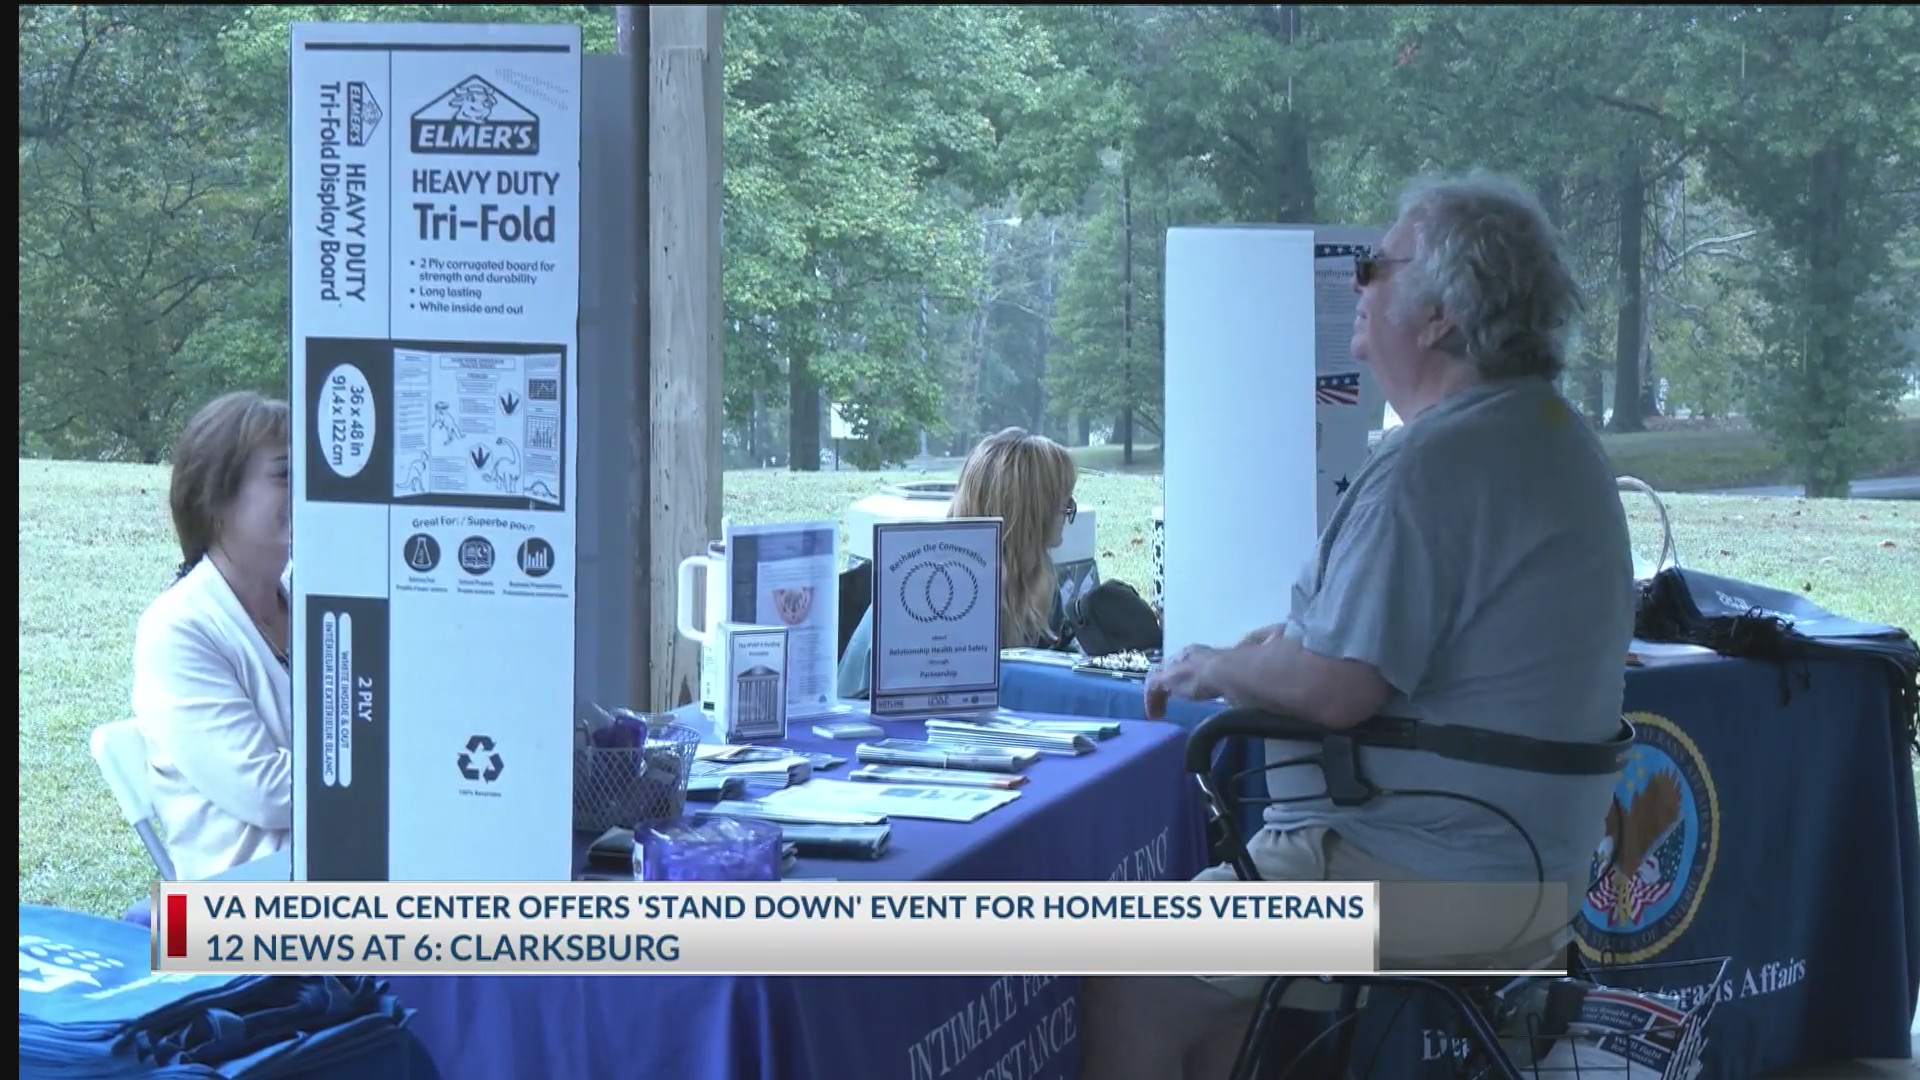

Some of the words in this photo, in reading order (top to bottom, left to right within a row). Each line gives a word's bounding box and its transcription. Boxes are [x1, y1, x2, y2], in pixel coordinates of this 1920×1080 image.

[320, 82, 341, 159] Tri-Fold
[350, 88, 362, 145] ELMER'S
[418, 124, 533, 149] ELMER'S
[412, 169, 492, 195] HEAVY
[496, 171, 560, 196] DUTY
[317, 163, 341, 237] Display
[345, 164, 366, 239] HEAVY
[412, 203, 556, 242] Tri-Fold
[320, 240, 341, 301] Board
[345, 243, 366, 302] DUTY
[420, 258, 428, 269] 2
[429, 258, 444, 270] Ply
[446, 260, 504, 271] corrugated
[506, 261, 538, 272] board
[540, 261, 556, 272] for
[419, 271, 462, 283] strength
[464, 272, 485, 283] and
[486, 272, 537, 285] durability
[420, 287, 445, 299] Long
[447, 287, 482, 299] lasting
[419, 301, 449, 313] White
[452, 301, 482, 314] inside
[484, 302, 504, 314] and
[506, 303, 524, 315] out
[332, 376, 346, 403] 91.4
[351, 385, 364, 402] 36
[332, 406, 343, 416] x
[351, 407, 361, 417] x
[332, 419, 346, 443] 122
[351, 420, 364, 445] 48
[332, 444, 343, 466] cm
[351, 447, 364, 457] in
[412, 516, 439, 529] Great
[467, 516, 508, 529] Superbe
[889, 547, 922, 574] Reshape
[923, 543, 937, 554] the
[938, 541, 987, 569] Conversation
[889, 647, 930, 657] Relationship
[931, 645, 953, 654] Health
[954, 645, 967, 653] and
[967, 643, 988, 653] Safety
[340, 651, 350, 683] WHITE
[919, 670, 958, 679] Partnership
[358, 677, 372, 688] 2
[340, 684, 350, 717] INSIDE
[358, 690, 372, 722] PLY
[340, 728, 350, 749] OUT
[1739, 954, 1807, 999] Affairs
[907, 975, 1017, 1080] INTIMATE
